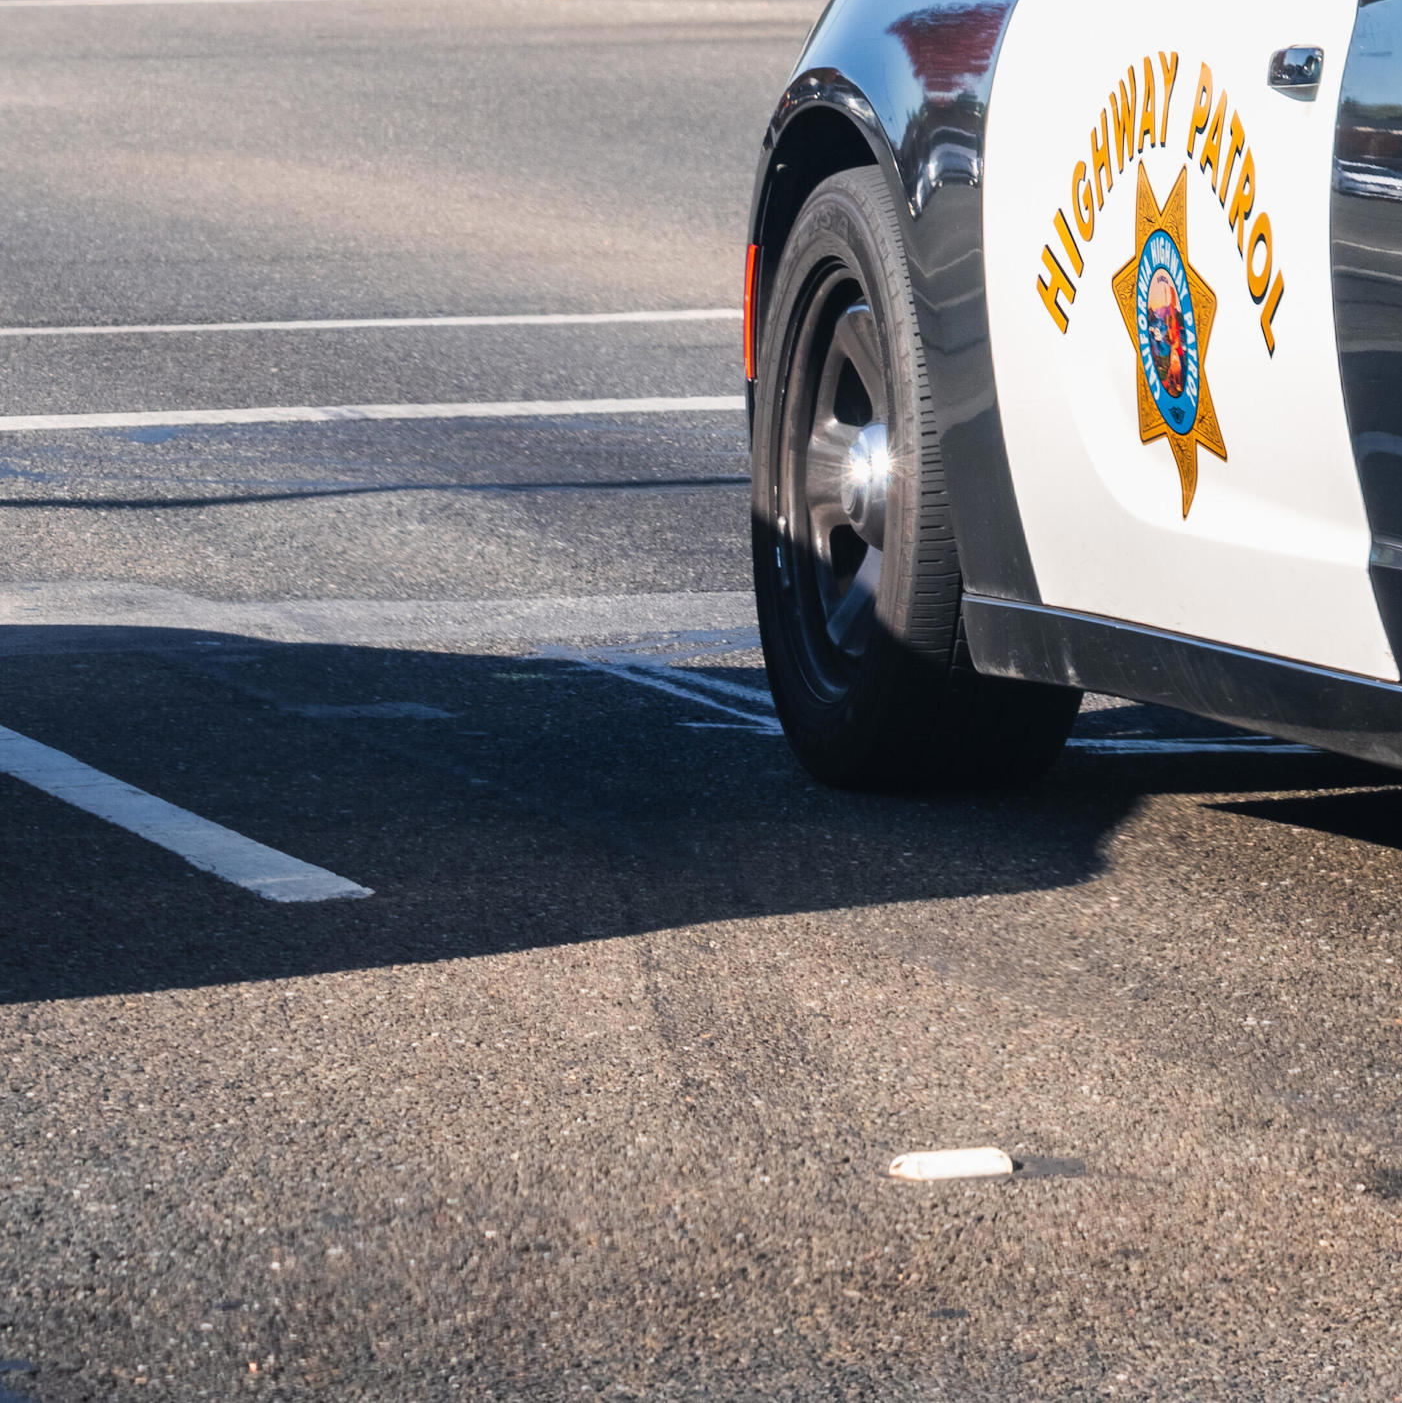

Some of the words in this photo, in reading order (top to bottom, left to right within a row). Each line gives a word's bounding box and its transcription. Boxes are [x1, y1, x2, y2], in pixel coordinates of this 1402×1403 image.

[1036, 51, 1178, 336] HIGHWAY
[1186, 61, 1285, 360] PATROL
[1137, 254, 1160, 401] CALIFORNIA
[1150, 236, 1189, 301] HIGHWAY
[1183, 310, 1198, 408] PATROL
